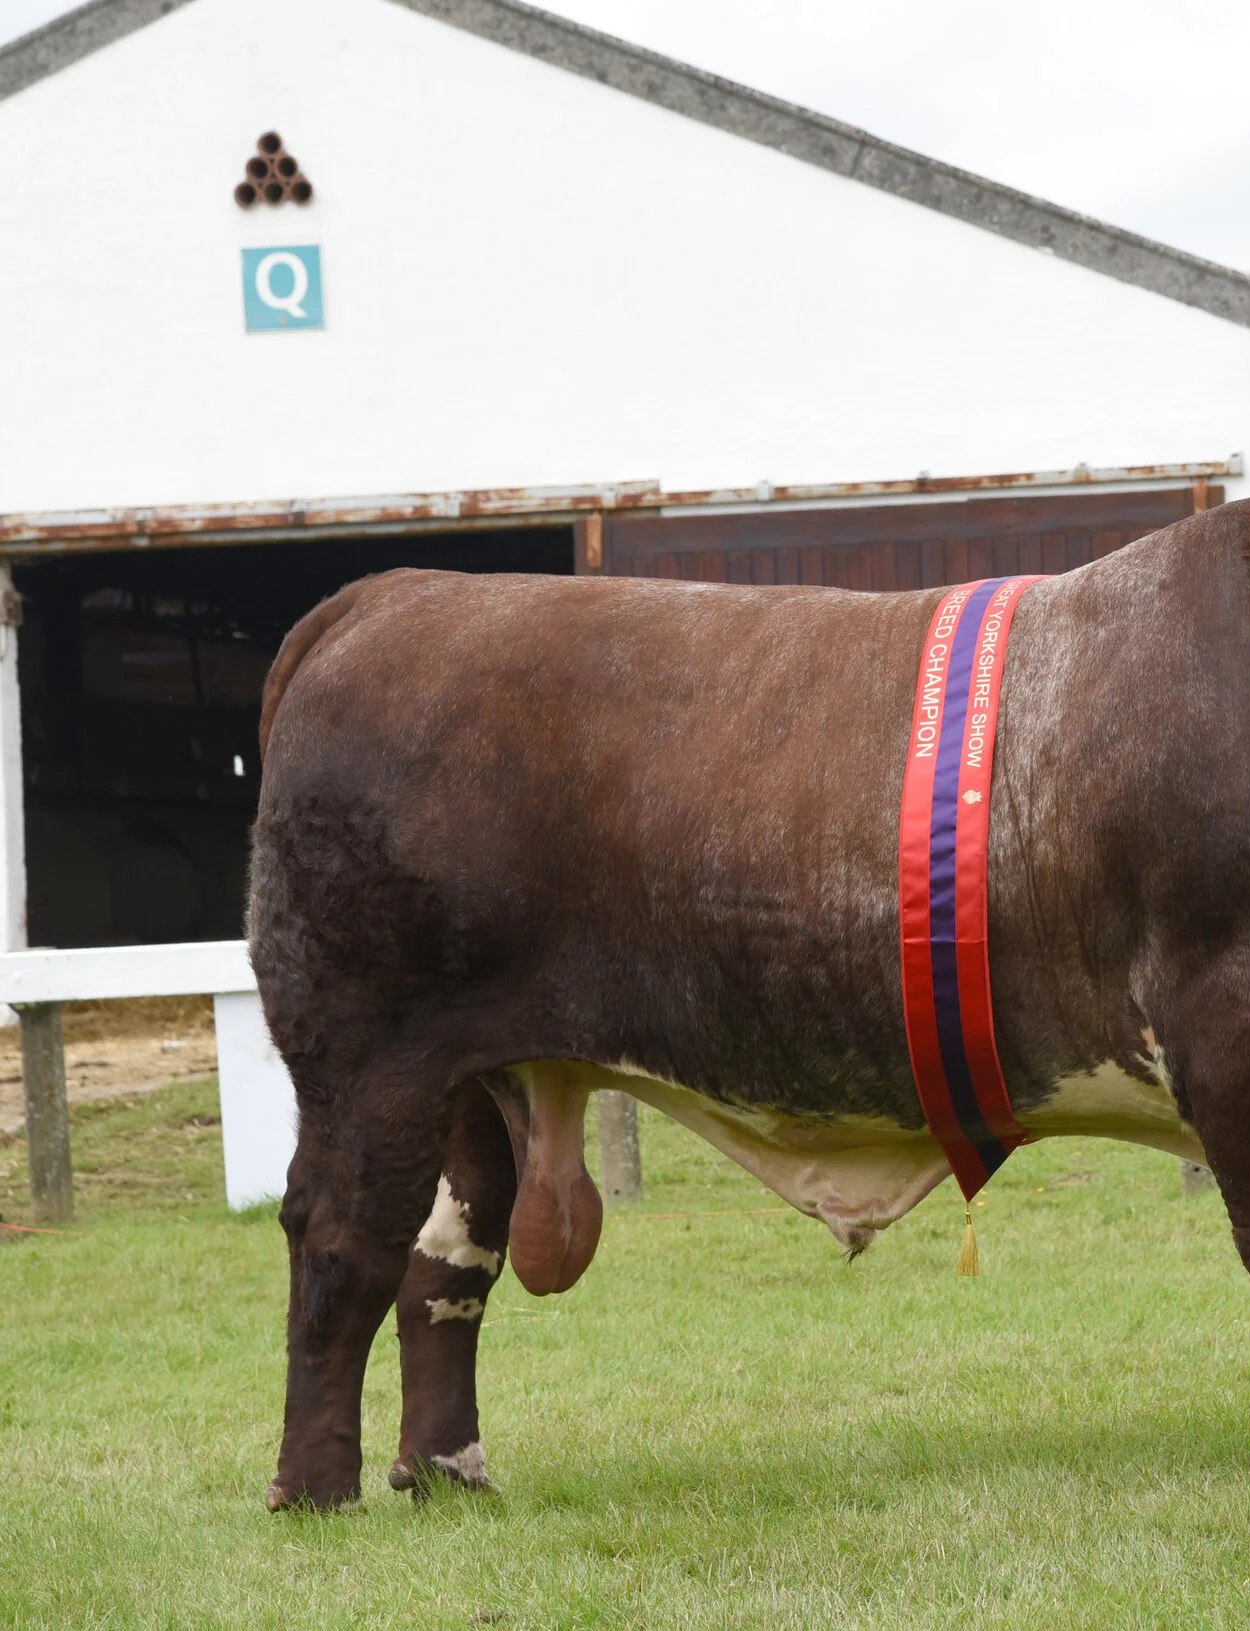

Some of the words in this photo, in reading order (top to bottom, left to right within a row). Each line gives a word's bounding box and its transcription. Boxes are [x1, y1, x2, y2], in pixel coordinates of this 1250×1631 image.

[255, 252, 308, 318] Q
[935, 590, 971, 639] BREED
[993, 580, 1023, 608] GREAT
[974, 610, 1004, 708] YORKSHIRE
[915, 644, 947, 758] CHAMPION
[966, 713, 987, 767] SHOW
